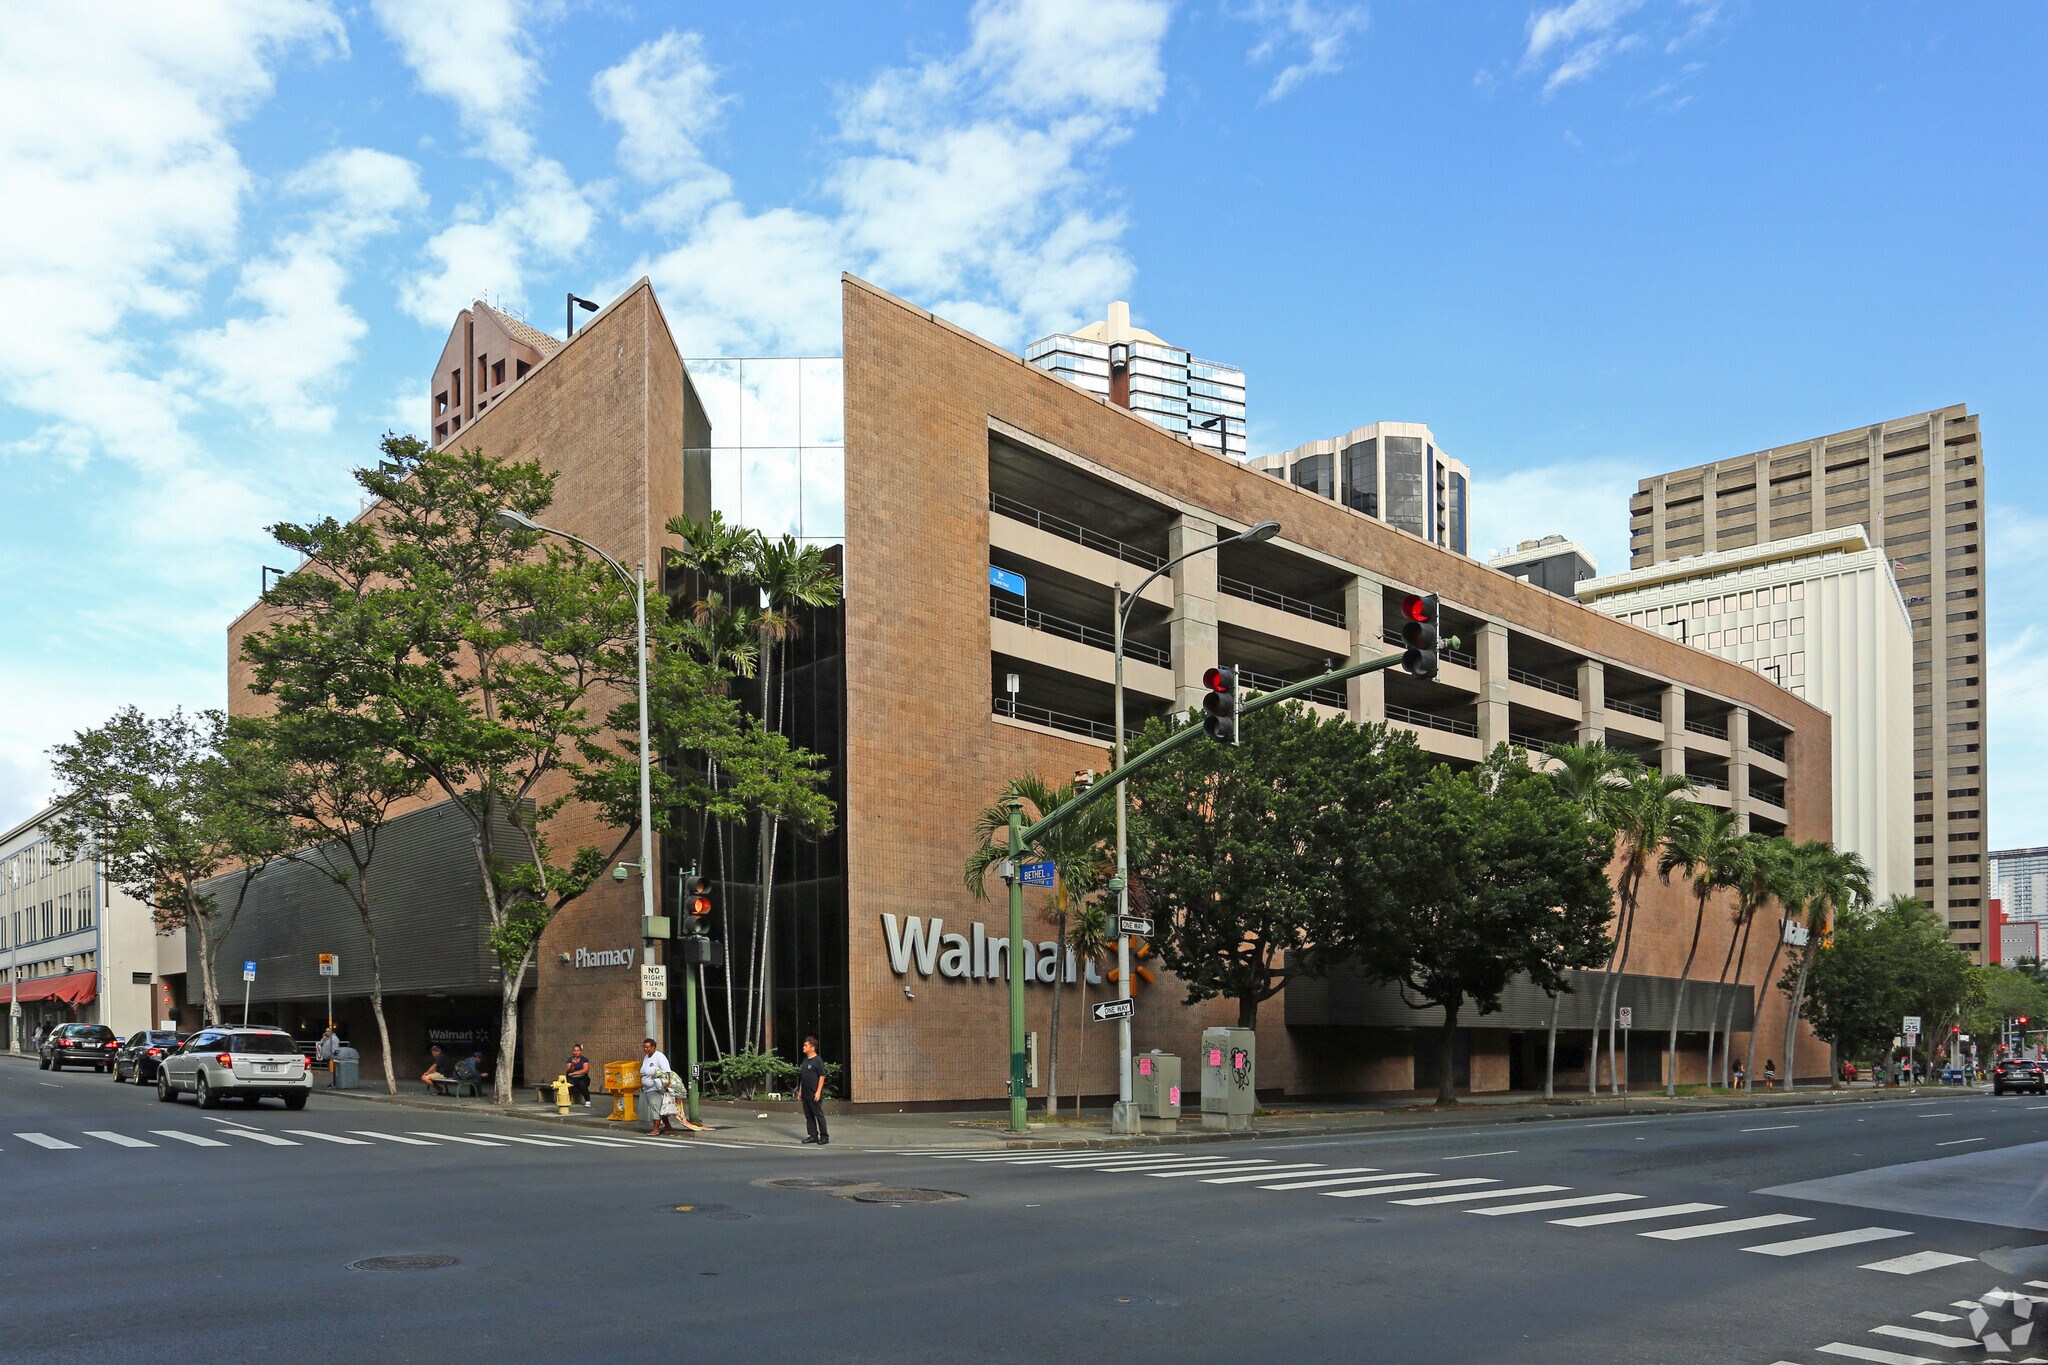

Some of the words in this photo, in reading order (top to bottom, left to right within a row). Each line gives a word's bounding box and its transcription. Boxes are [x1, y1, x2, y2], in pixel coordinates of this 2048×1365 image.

[1024, 869, 1045, 880] BETHEL
[1123, 921, 1133, 929] ONE
[1134, 922, 1144, 930] WAY
[575, 947, 635, 970] Pharmacy
[1104, 1006, 1115, 1015] ONE
[1117, 1004, 1128, 1012] WAY
[429, 1029, 474, 1040] Walmart
